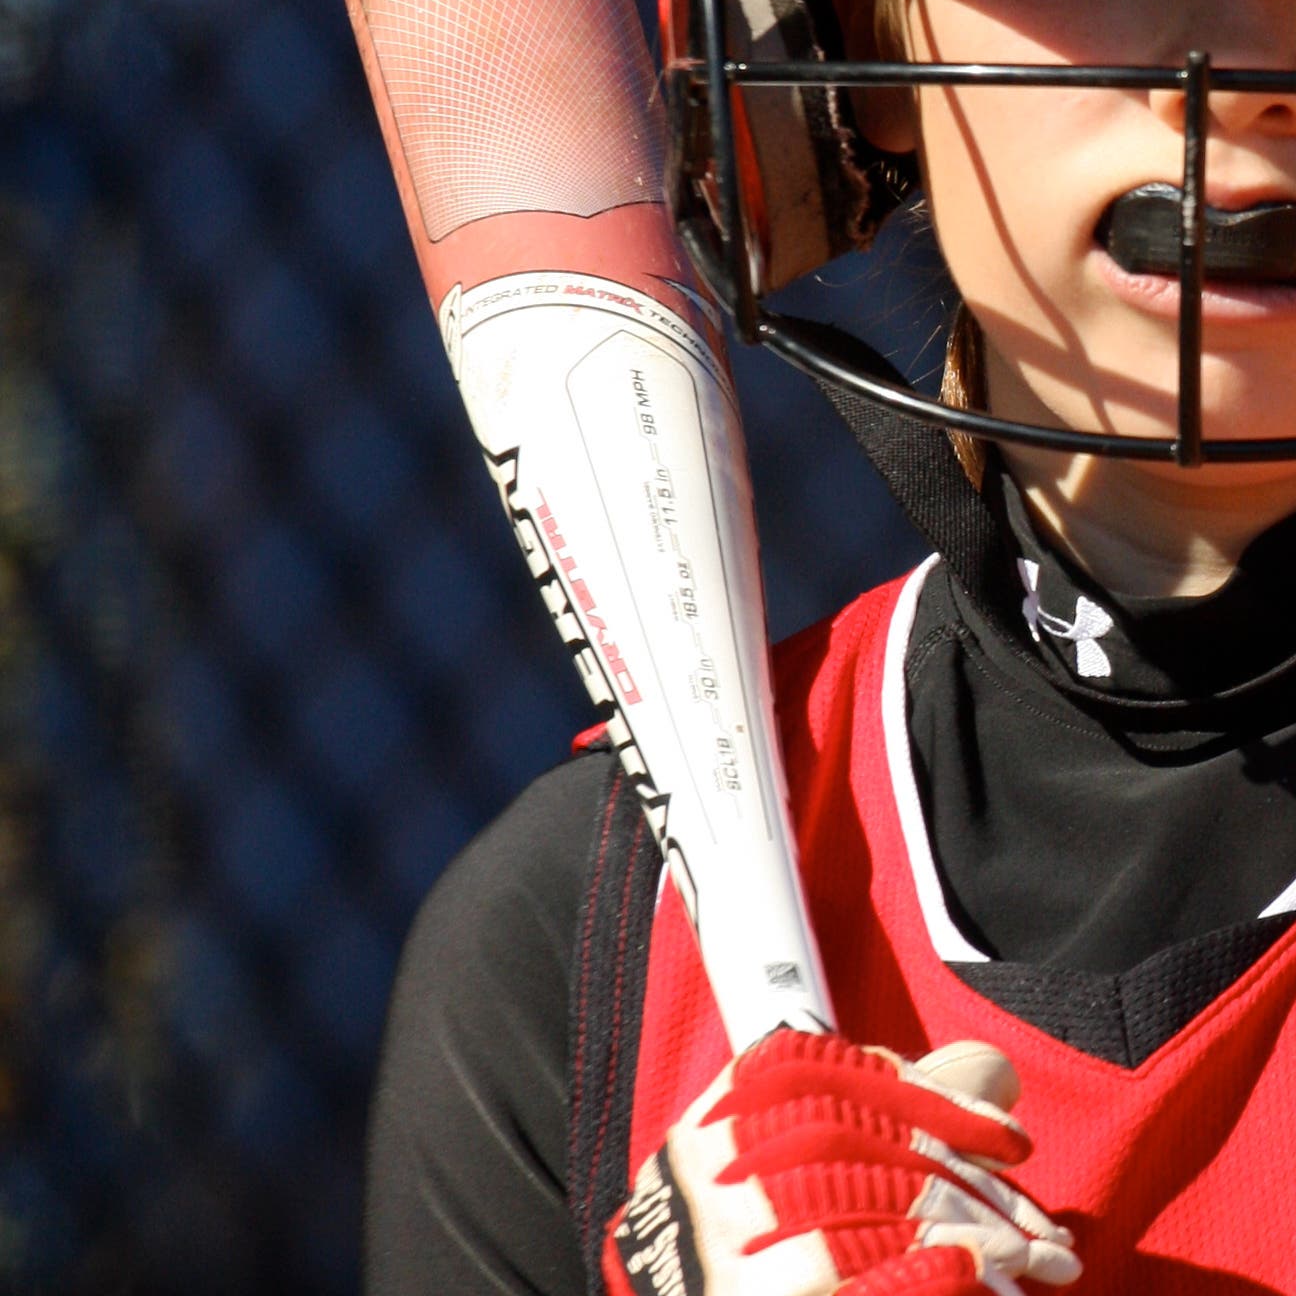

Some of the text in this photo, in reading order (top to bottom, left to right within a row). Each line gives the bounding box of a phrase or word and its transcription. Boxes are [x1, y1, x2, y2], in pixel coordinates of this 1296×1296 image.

[562, 284, 645, 316] MATRIX
[629, 368, 658, 436] 98 MPH
[655, 487, 679, 526] 11.5
[536, 486, 643, 706] CRYSTAL
[679, 586, 700, 621] 18.5
[701, 675, 719, 701] 30
